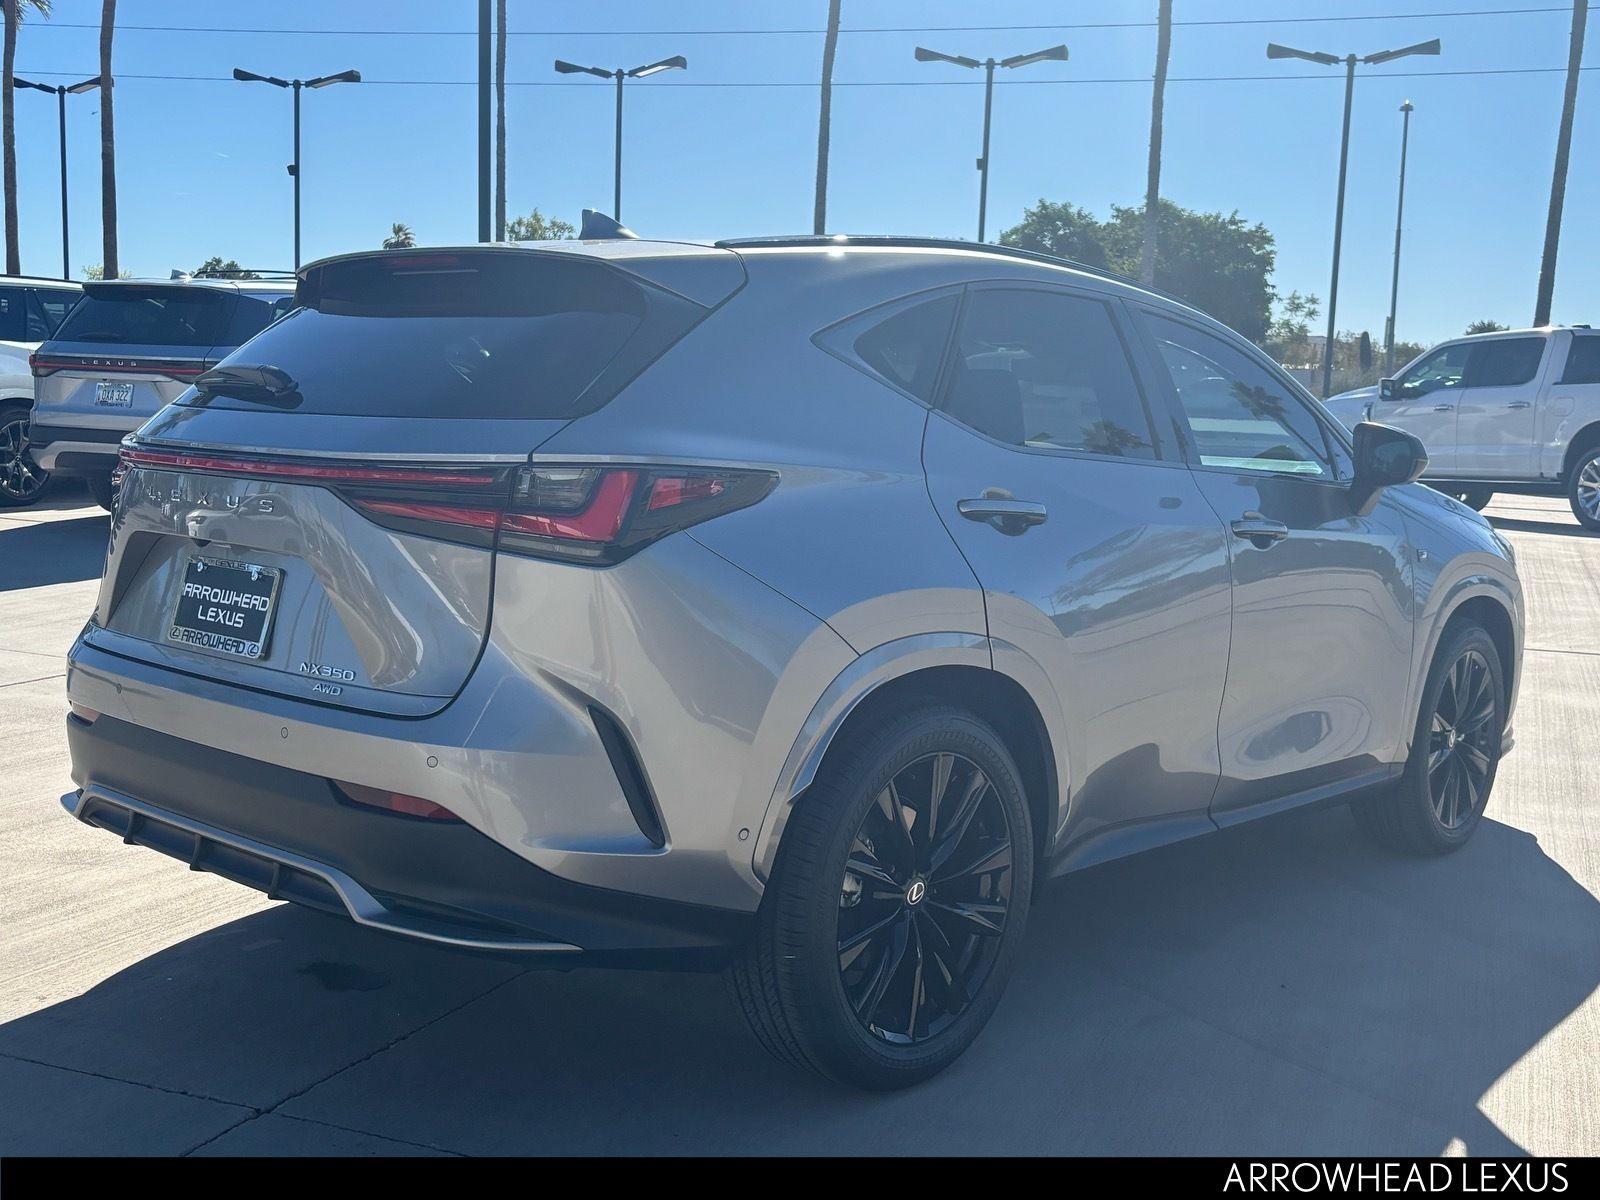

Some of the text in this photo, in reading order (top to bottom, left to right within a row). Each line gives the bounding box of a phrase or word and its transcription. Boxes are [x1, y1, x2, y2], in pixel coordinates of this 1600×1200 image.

[81, 359, 137, 367] LEXUS
[147, 485, 274, 513] LEXUS
[215, 560, 247, 571] LEXUS
[183, 582, 270, 612] ARROWHEAD
[197, 605, 245, 629] LEXUS
[181, 629, 246, 655] ARROWHEAD
[299, 662, 356, 681] NX350
[312, 683, 343, 696] AWD
